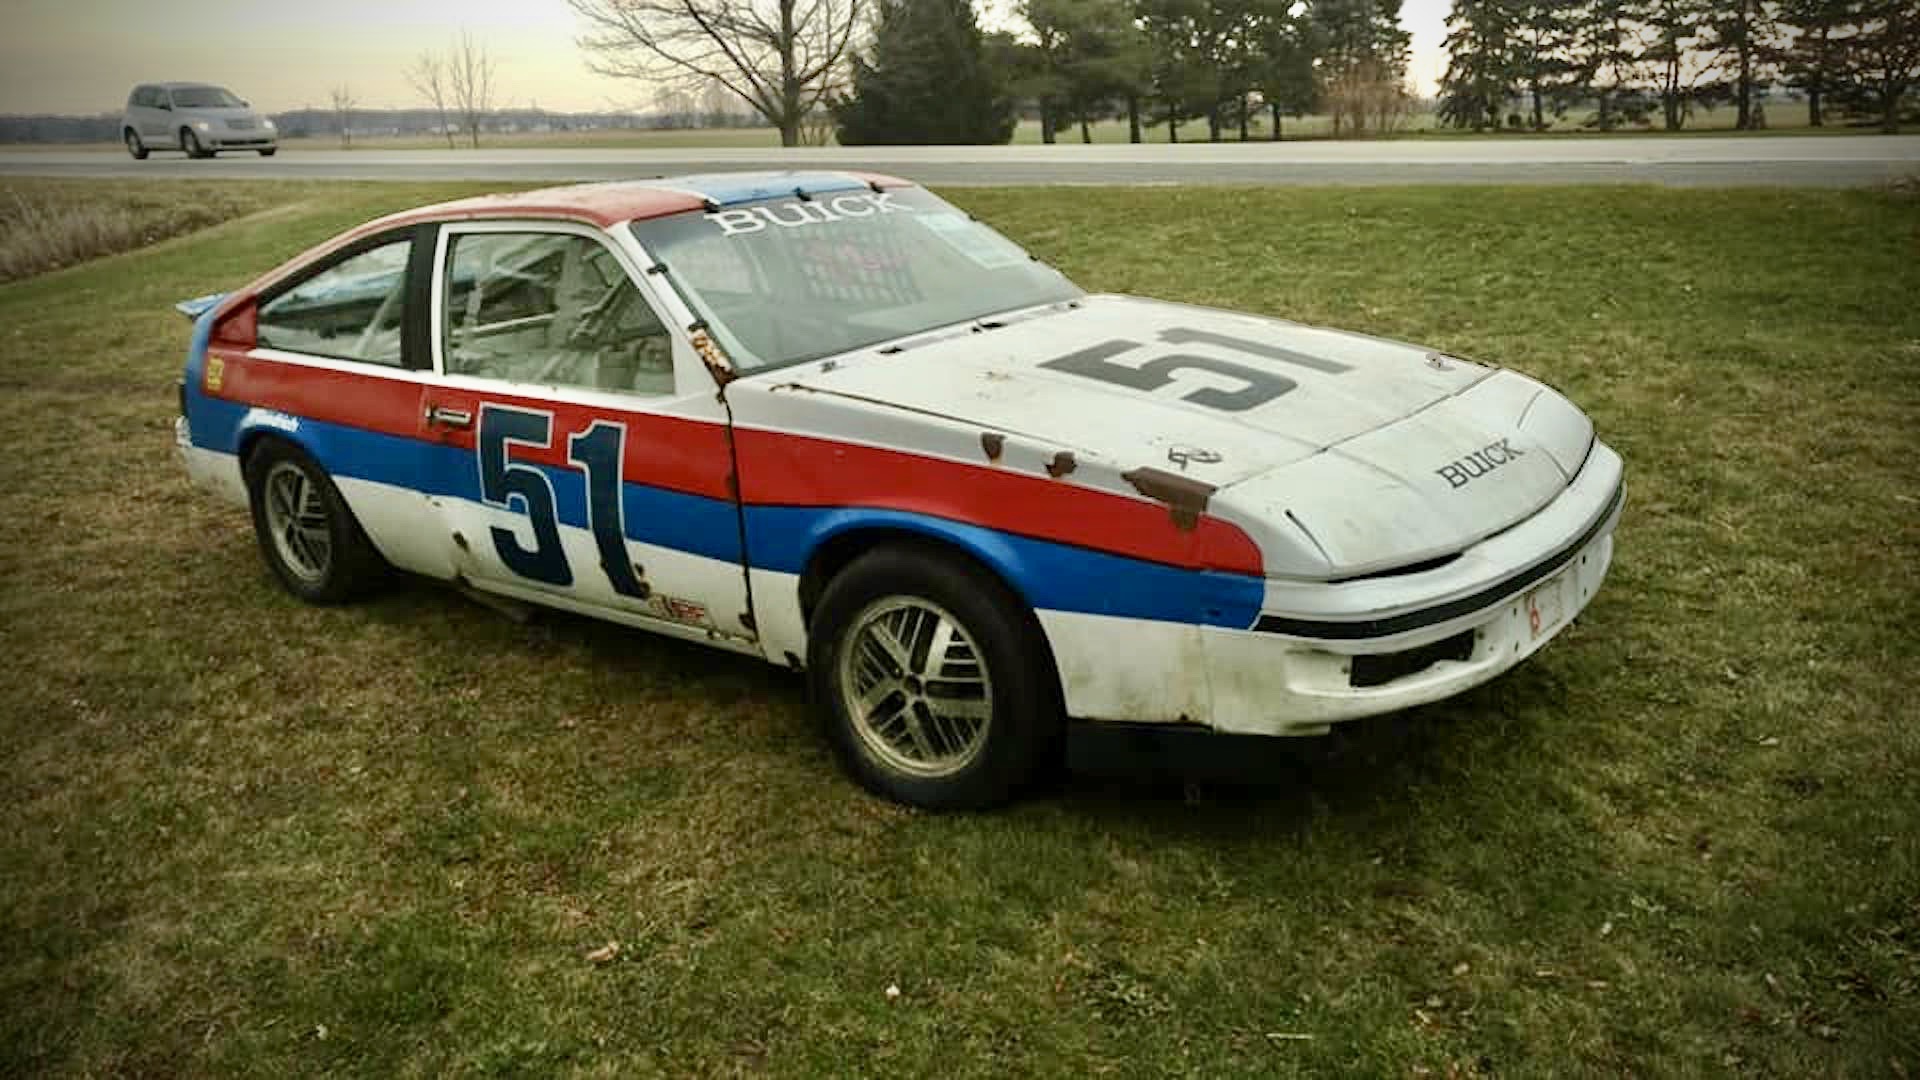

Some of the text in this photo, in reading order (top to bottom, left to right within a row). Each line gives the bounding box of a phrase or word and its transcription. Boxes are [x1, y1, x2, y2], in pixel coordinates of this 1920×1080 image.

[703, 192, 913, 237] BUICK
[1036, 327, 1355, 412] 51
[1435, 437, 1525, 489] BUICK
[477, 401, 651, 601] 51
